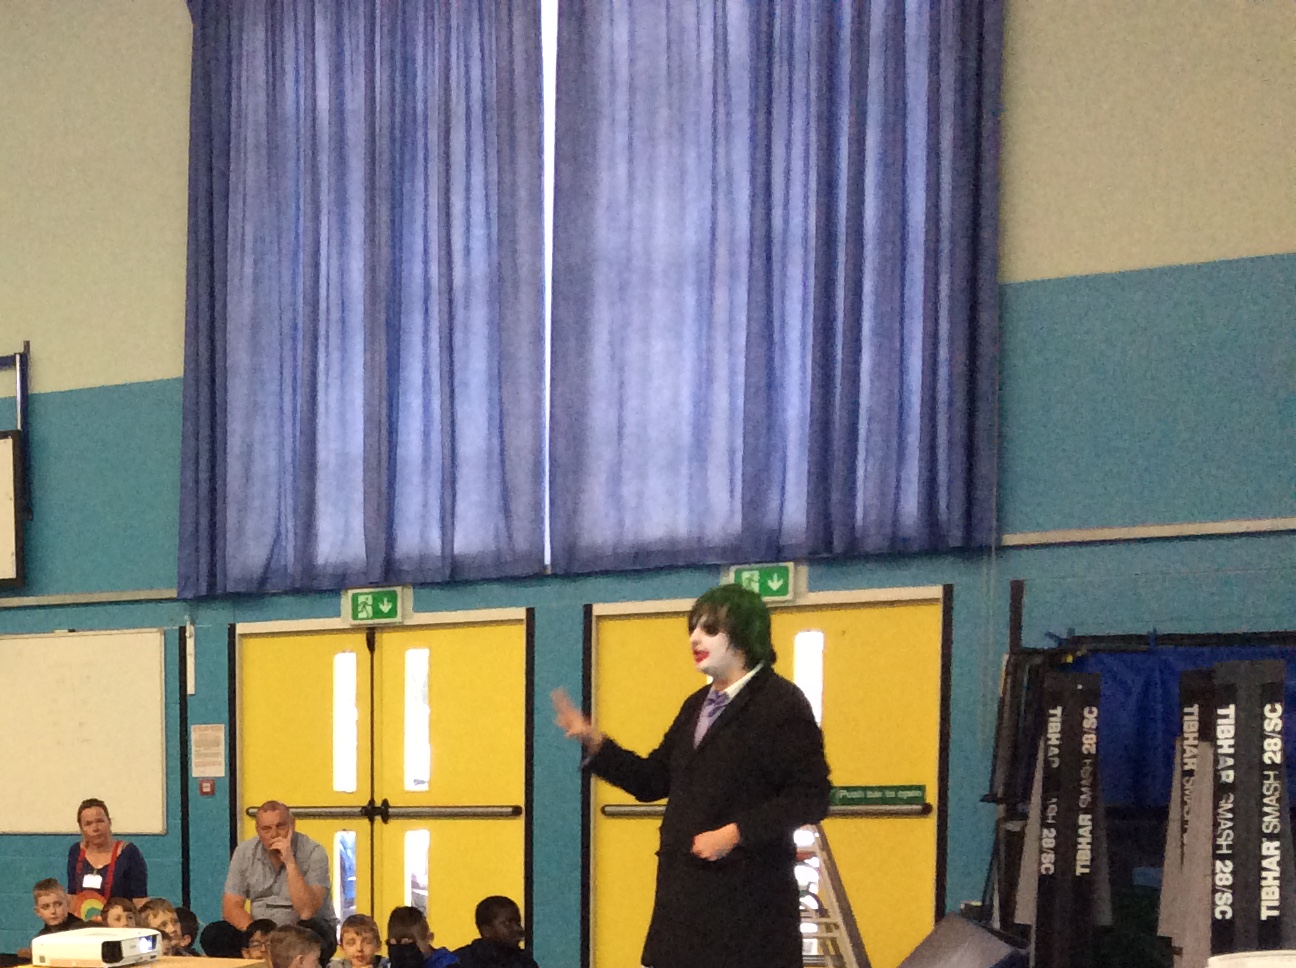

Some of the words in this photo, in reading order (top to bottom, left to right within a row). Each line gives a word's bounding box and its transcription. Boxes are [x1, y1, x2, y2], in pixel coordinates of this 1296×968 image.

[1082, 706, 1098, 755] 28/SC
[1216, 704, 1235, 783] TIBHAR
[1262, 702, 1282, 764] 28/SC
[1262, 770, 1280, 834] SMASH
[1041, 828, 1057, 875] 28/SC
[1075, 814, 1093, 876] TIBHAR
[1215, 860, 1233, 920] 28/SC
[1260, 838, 1281, 920] TIBHAR
